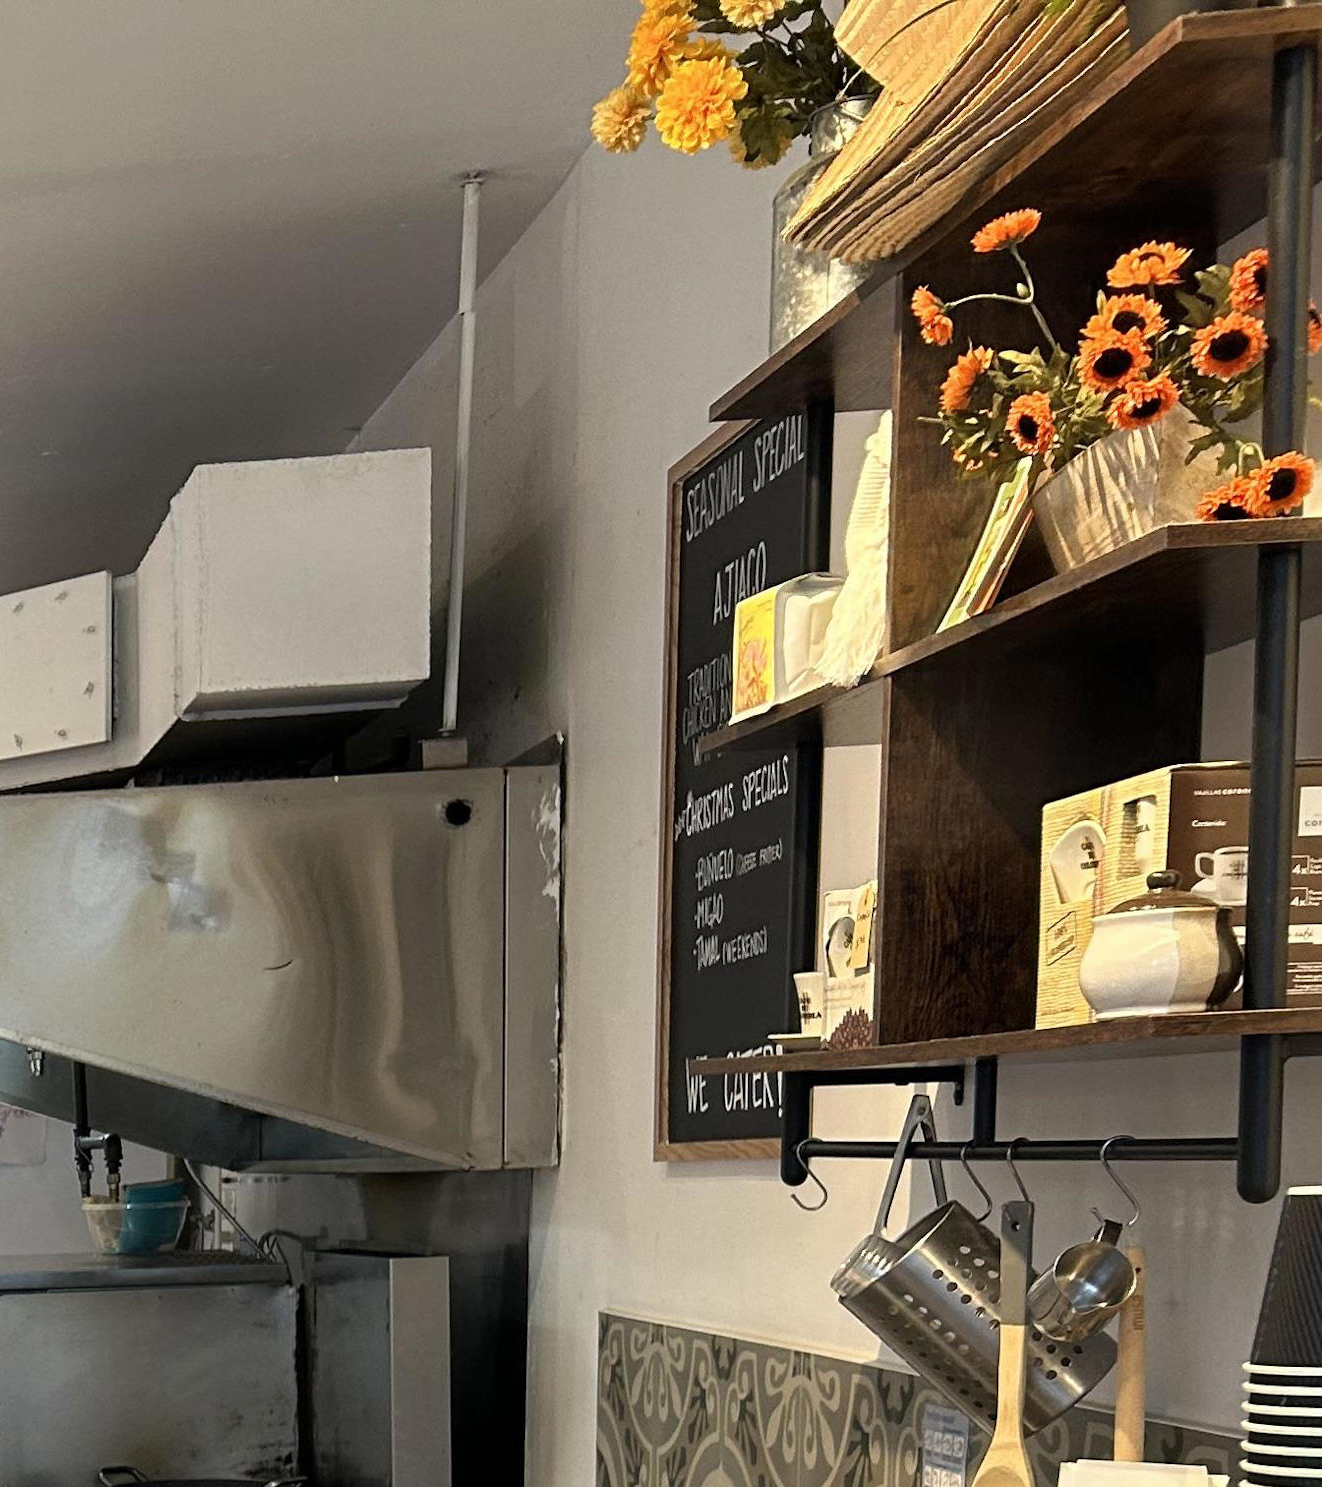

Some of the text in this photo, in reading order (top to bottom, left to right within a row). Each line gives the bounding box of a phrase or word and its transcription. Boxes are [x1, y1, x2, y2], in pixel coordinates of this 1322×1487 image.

[685, 414, 804, 542] SEASONAL SPECIAL
[686, 754, 789, 836] CHRISTMAS SPECIALS
